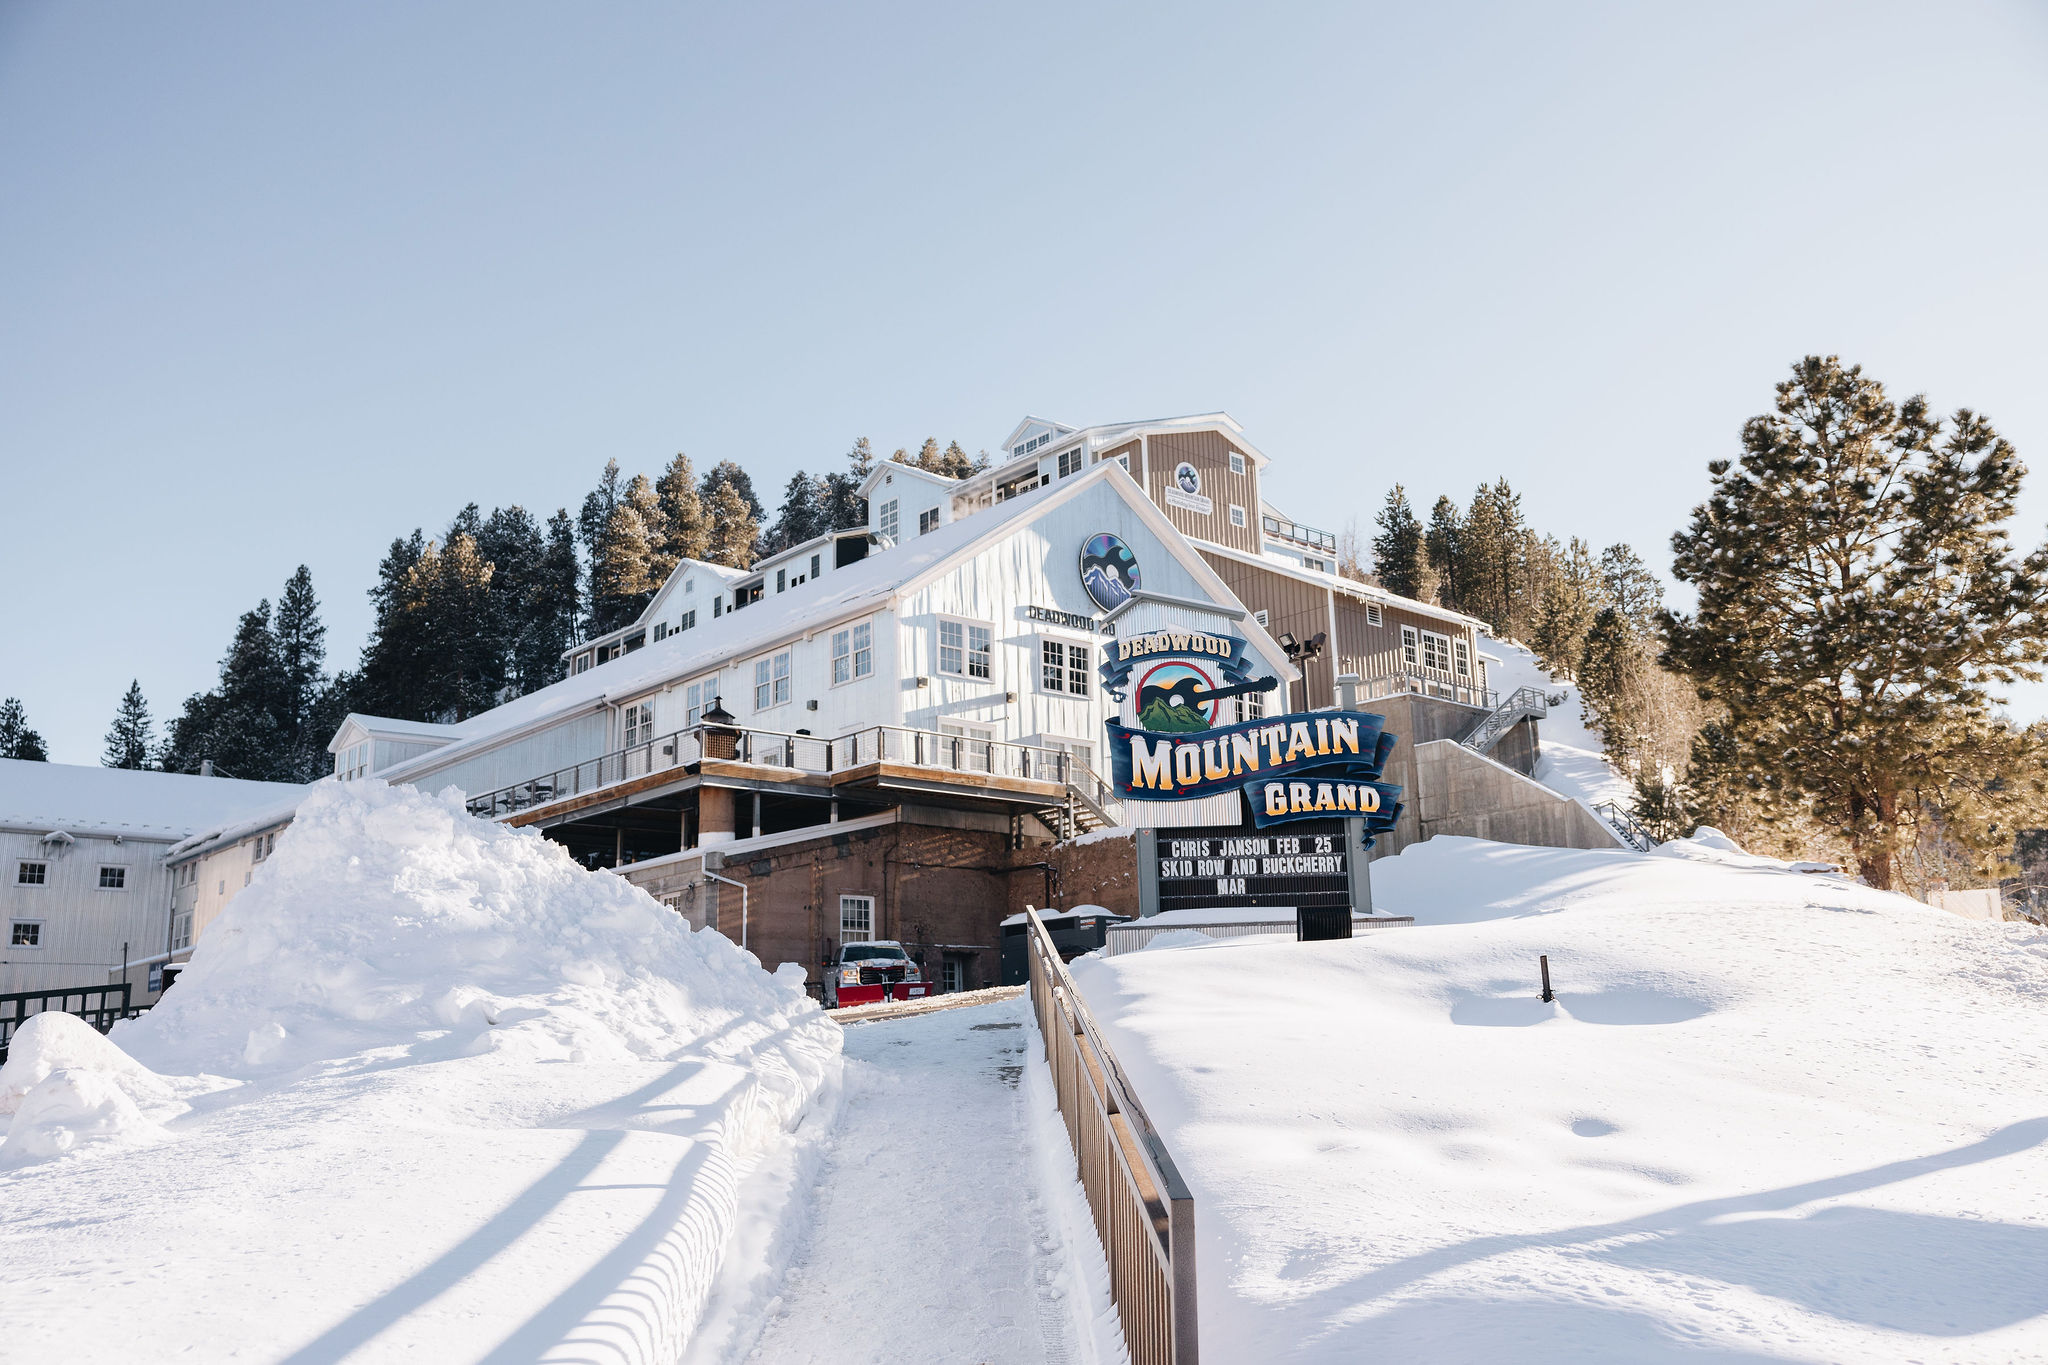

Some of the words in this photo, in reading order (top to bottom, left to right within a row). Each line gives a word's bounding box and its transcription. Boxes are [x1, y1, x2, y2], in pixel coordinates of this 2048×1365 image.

[1029, 605, 1095, 631] DEADWOOD
[1118, 633, 1232, 661] DEADWOOD
[1129, 718, 1360, 791] MOUNTAIN
[1263, 782, 1381, 817] GRAND
[1171, 840, 1210, 858] CHRIS
[1220, 838, 1270, 857] JANSON
[1277, 838, 1300, 854] FEB
[1315, 837, 1332, 853] 25
[1161, 860, 1193, 877] SKID
[1197, 859, 1226, 876] ROW
[1231, 859, 1257, 875] AND
[1263, 856, 1342, 874] BUCKCHERRY
[1217, 878, 1246, 895] MAR
